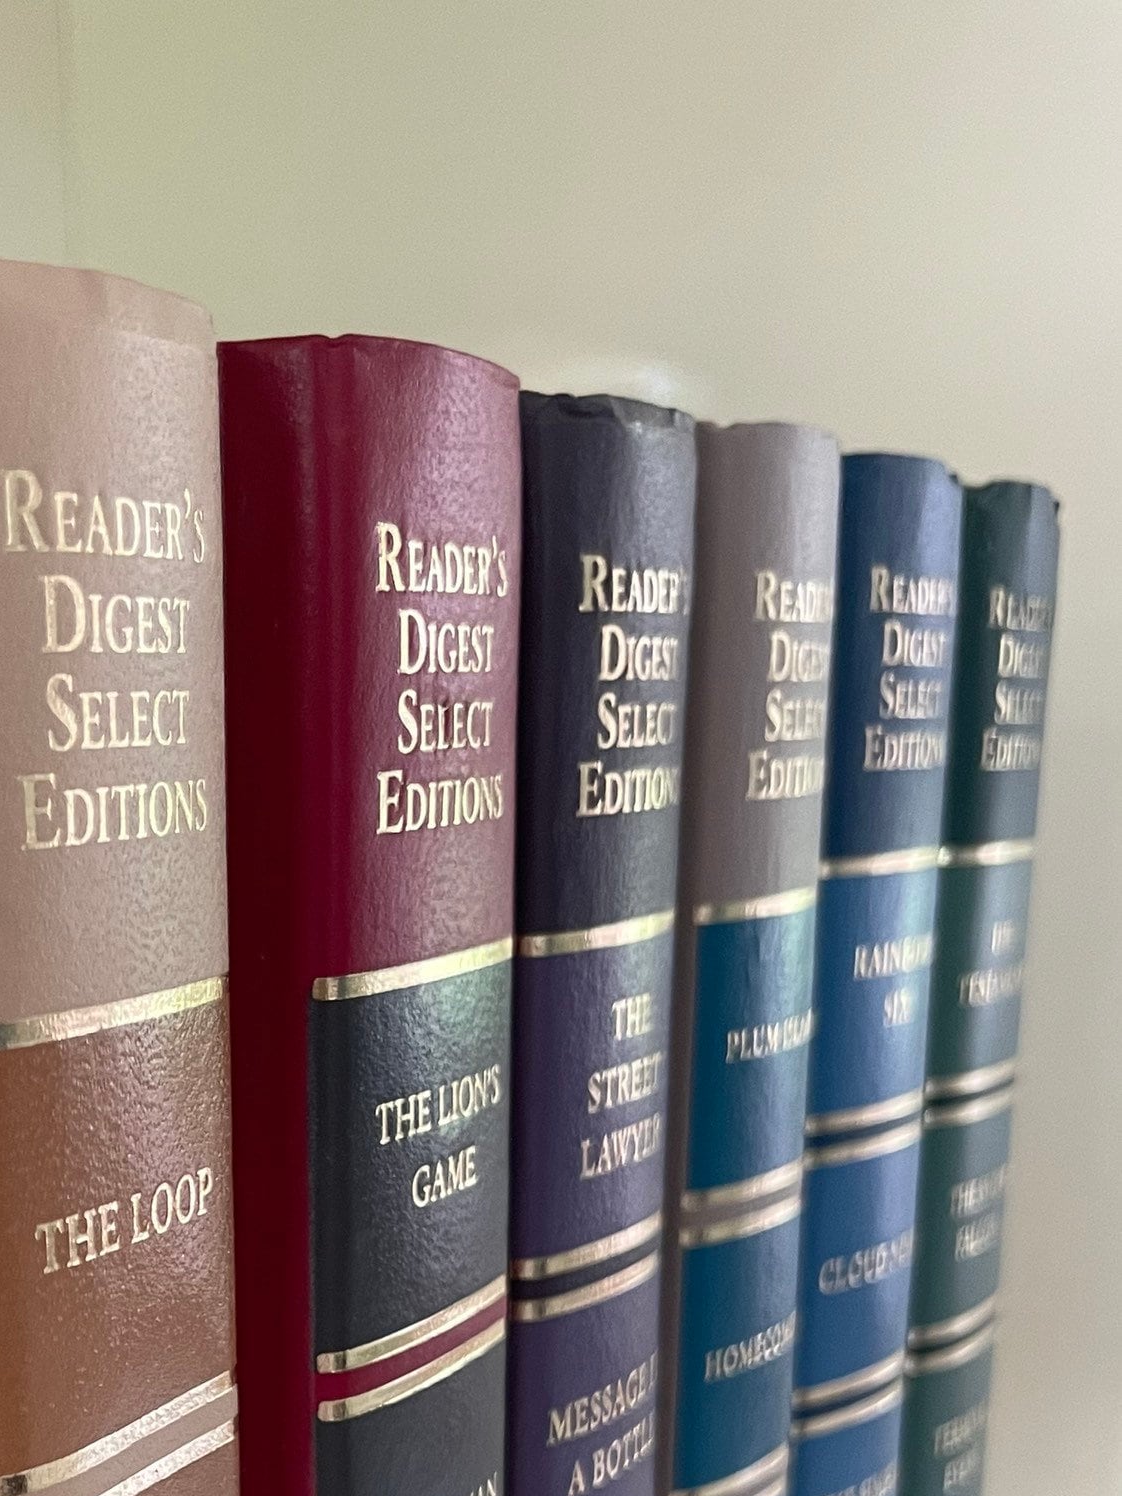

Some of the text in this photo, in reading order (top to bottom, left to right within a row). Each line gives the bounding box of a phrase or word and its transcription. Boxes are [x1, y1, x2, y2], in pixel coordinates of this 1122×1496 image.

[2, 469, 205, 563] READER'S
[376, 521, 508, 597] READER'S
[42, 575, 190, 654] DIGEST
[396, 609, 494, 675] DIGEST
[47, 674, 189, 752] SELECT
[397, 689, 493, 755] SELECT
[18, 774, 208, 851] EDITIONS
[376, 769, 504, 834] EDITIONS
[575, 760, 680, 818] EDITION
[612, 992, 653, 1041] THE
[726, 1022, 780, 1064] PLUM
[375, 1063, 501, 1145] THE LION'S
[587, 1051, 663, 1115] STREET
[412, 1145, 478, 1208] GAME
[580, 1112, 661, 1180] LAWYER
[35, 1167, 213, 1275] THE LOOP
[547, 1361, 647, 1447] MESSAGE
